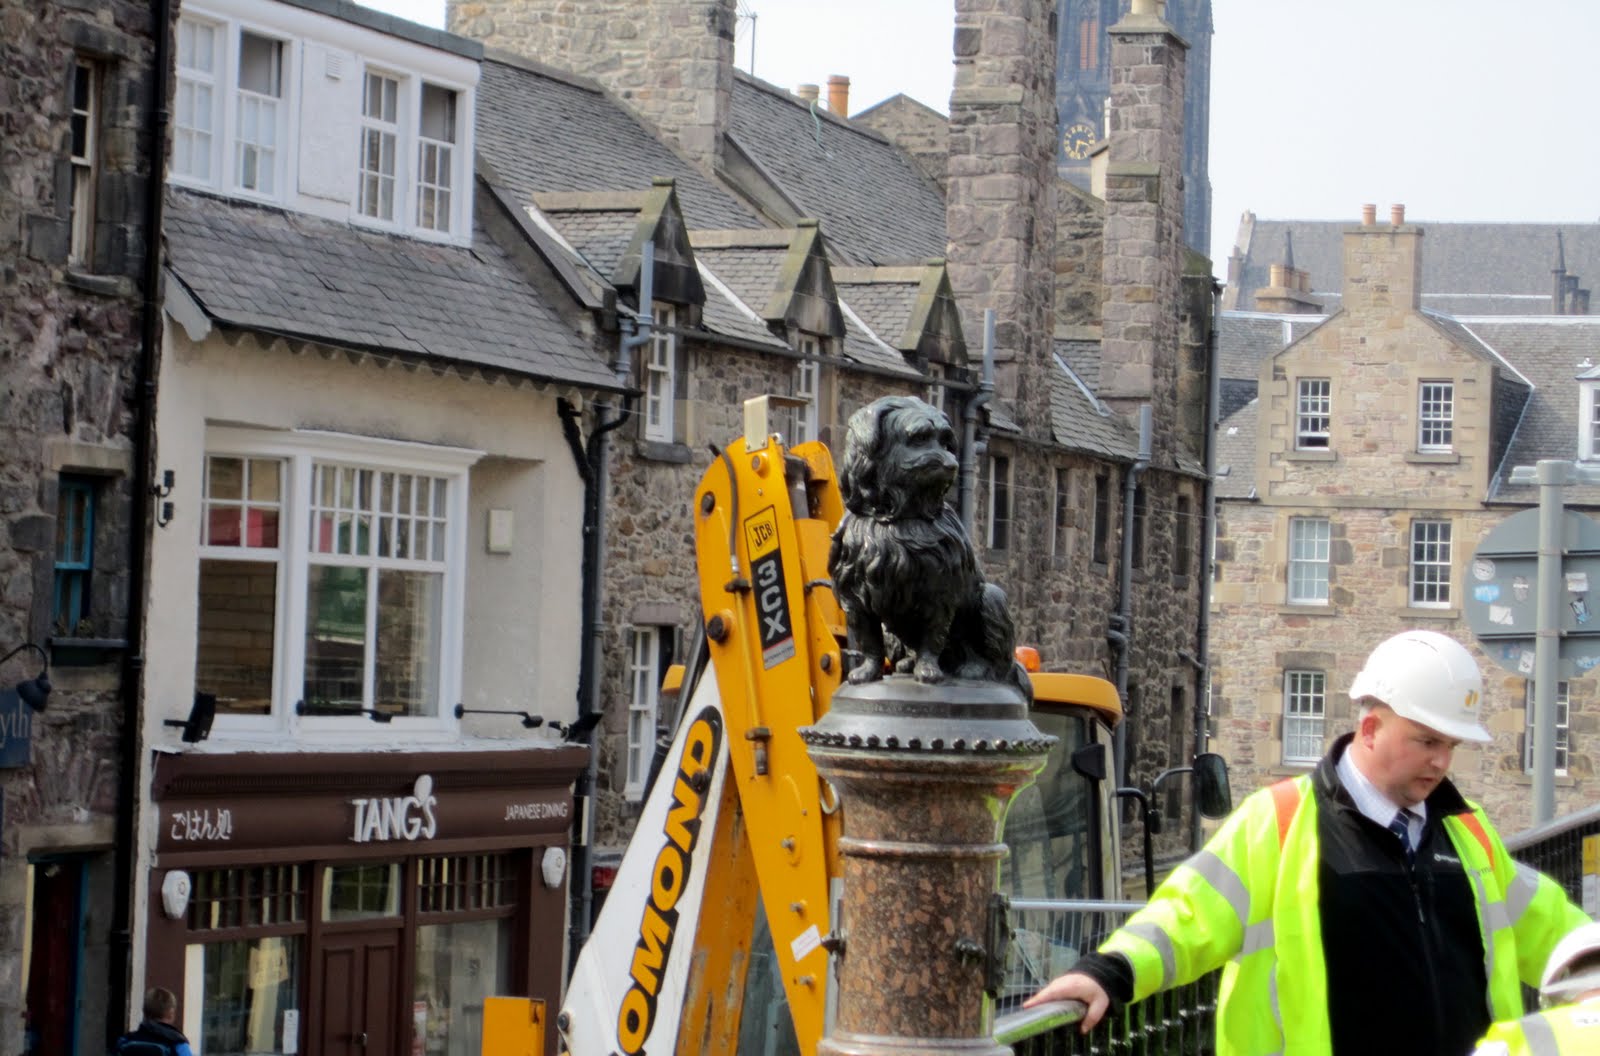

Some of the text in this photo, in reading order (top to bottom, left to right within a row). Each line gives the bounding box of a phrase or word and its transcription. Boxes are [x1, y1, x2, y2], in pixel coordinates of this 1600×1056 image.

[753, 523, 773, 548] JCB
[757, 559, 787, 641] 3CX
[171, 808, 233, 841] ごはん処
[504, 803, 541, 821] JAPANESE
[609, 705, 722, 1056] OMOND
